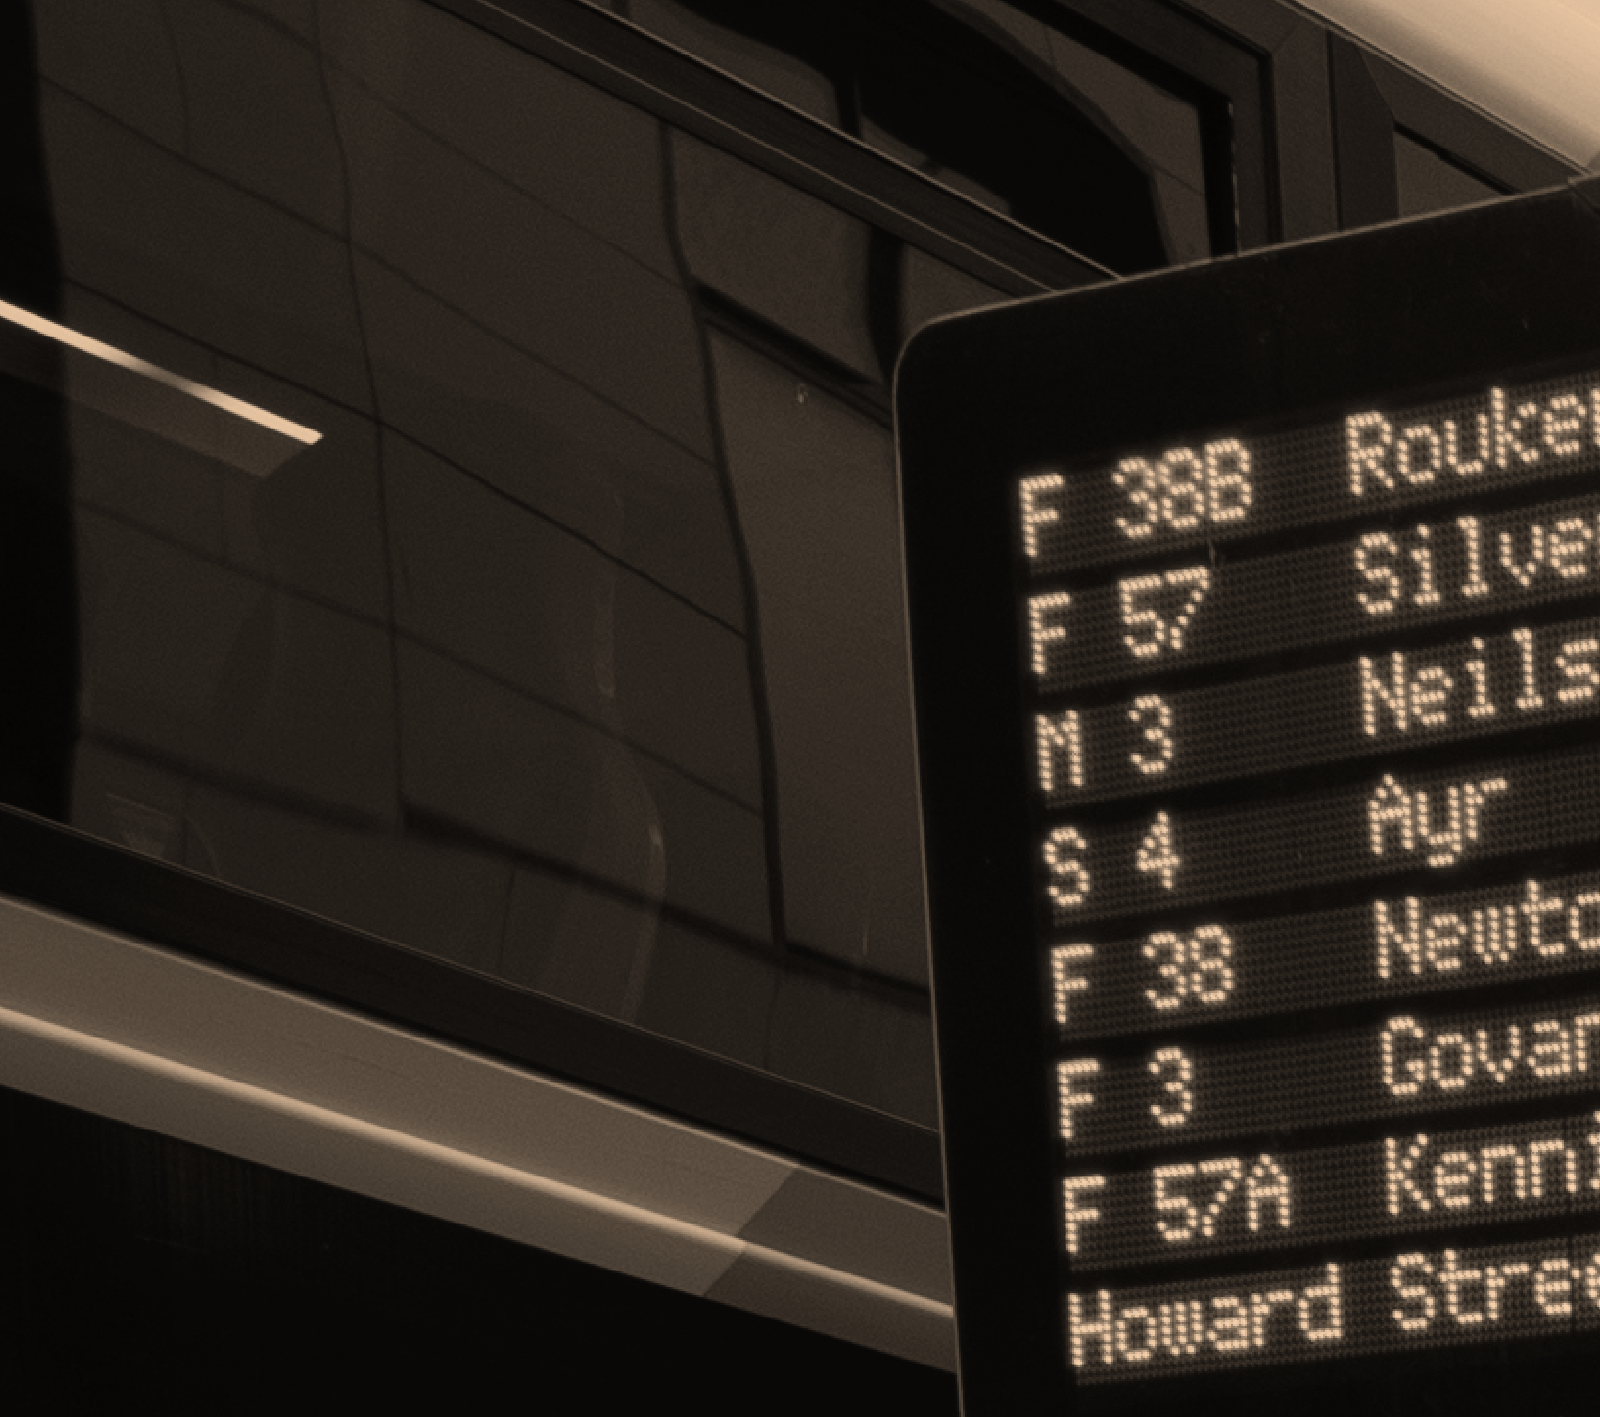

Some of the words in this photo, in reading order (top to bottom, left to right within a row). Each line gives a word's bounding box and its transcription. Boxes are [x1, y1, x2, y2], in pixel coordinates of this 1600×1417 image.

[1017, 471, 1067, 560] F
[1109, 436, 1255, 541] 38B
[1026, 589, 1073, 677] F
[1116, 564, 1213, 660] 57
[1034, 707, 1086, 794] M
[1126, 692, 1176, 777] 3
[1041, 824, 1093, 909] S
[1134, 809, 1183, 892] 4
[1365, 772, 1510, 870] Ayr
[1049, 941, 1097, 1026] F
[1140, 922, 1237, 1013] 38
[1055, 1056, 1102, 1142] F
[1146, 1045, 1196, 1129] 3
[1061, 1172, 1109, 1256] F
[1150, 1151, 1294, 1244] 57A
[1066, 1260, 1345, 1370] Howard
